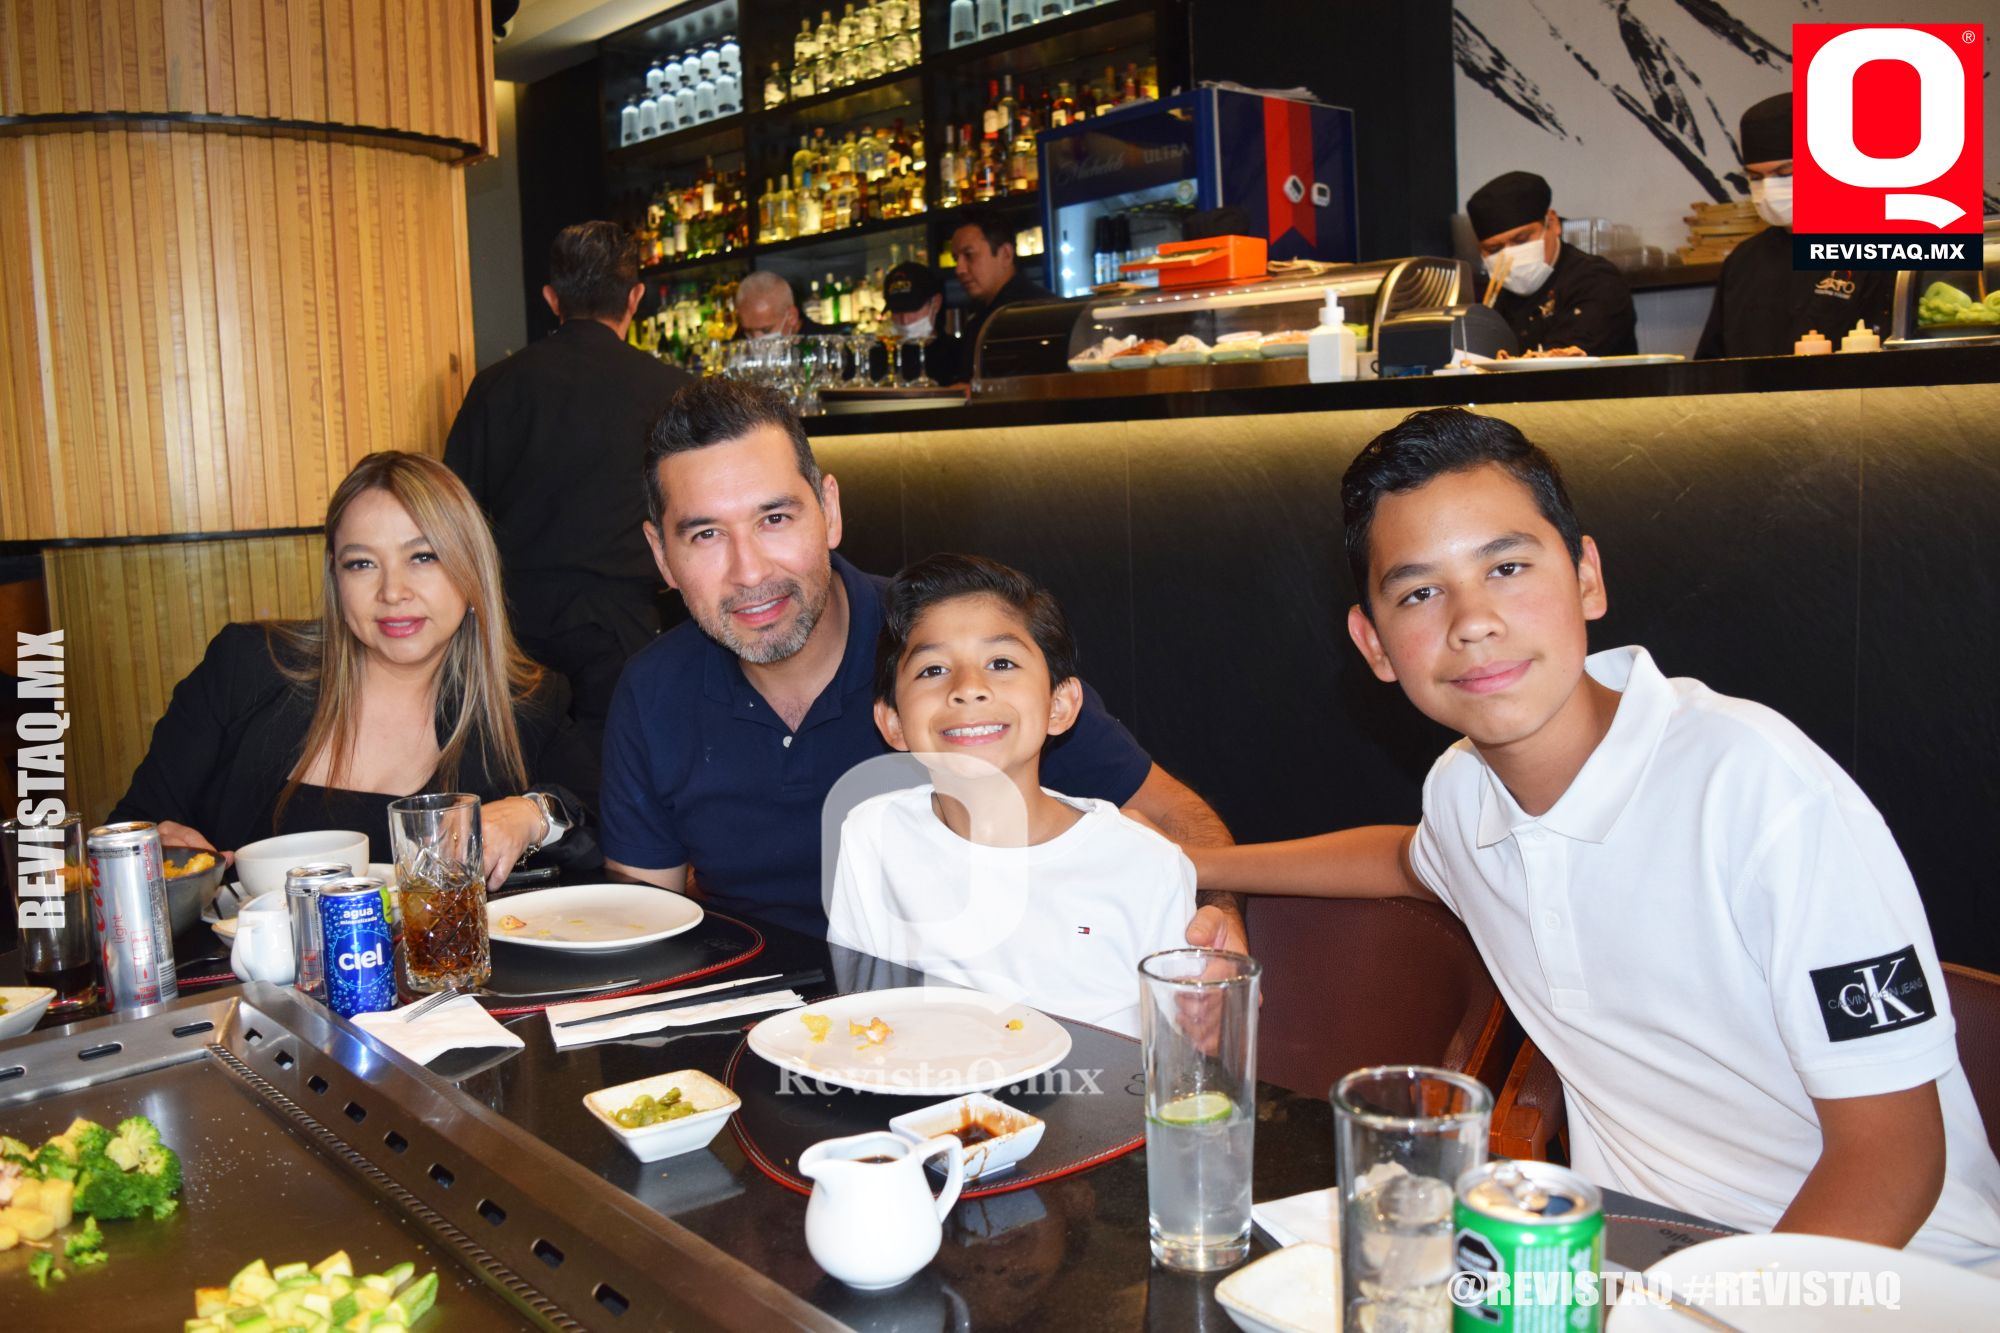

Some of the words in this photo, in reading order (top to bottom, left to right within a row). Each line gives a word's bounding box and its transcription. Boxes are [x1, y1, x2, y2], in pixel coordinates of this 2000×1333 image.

[1143, 142, 1190, 165] ULTRA
[342, 907, 374, 920] agua
[112, 914, 128, 944] light
[338, 942, 385, 972] ciel
[1899, 977, 1924, 995] JEANS
